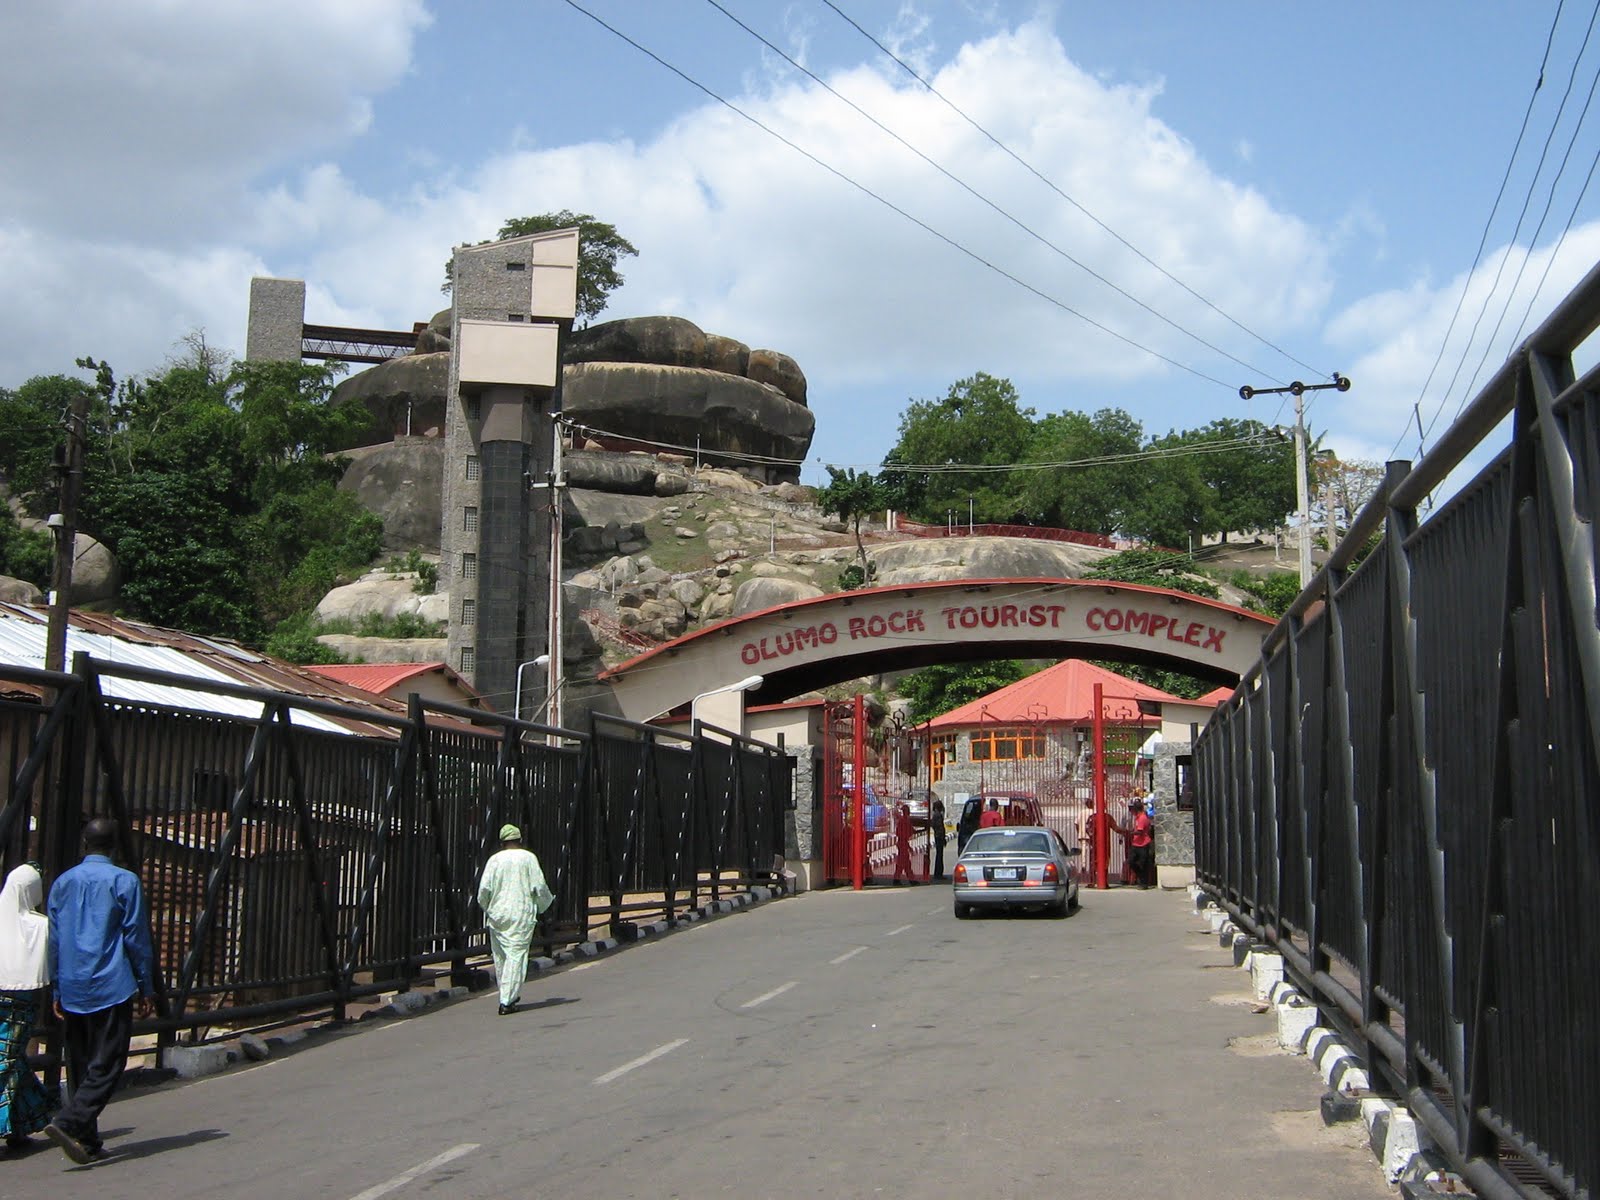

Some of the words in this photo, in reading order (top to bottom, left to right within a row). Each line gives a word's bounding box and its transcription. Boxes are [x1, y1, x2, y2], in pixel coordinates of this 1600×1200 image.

[741, 623, 838, 665] OLUMO
[849, 609, 925, 640] ROCK
[941, 605, 1066, 629] TOURIST
[1086, 607, 1226, 653] COMPLEX
